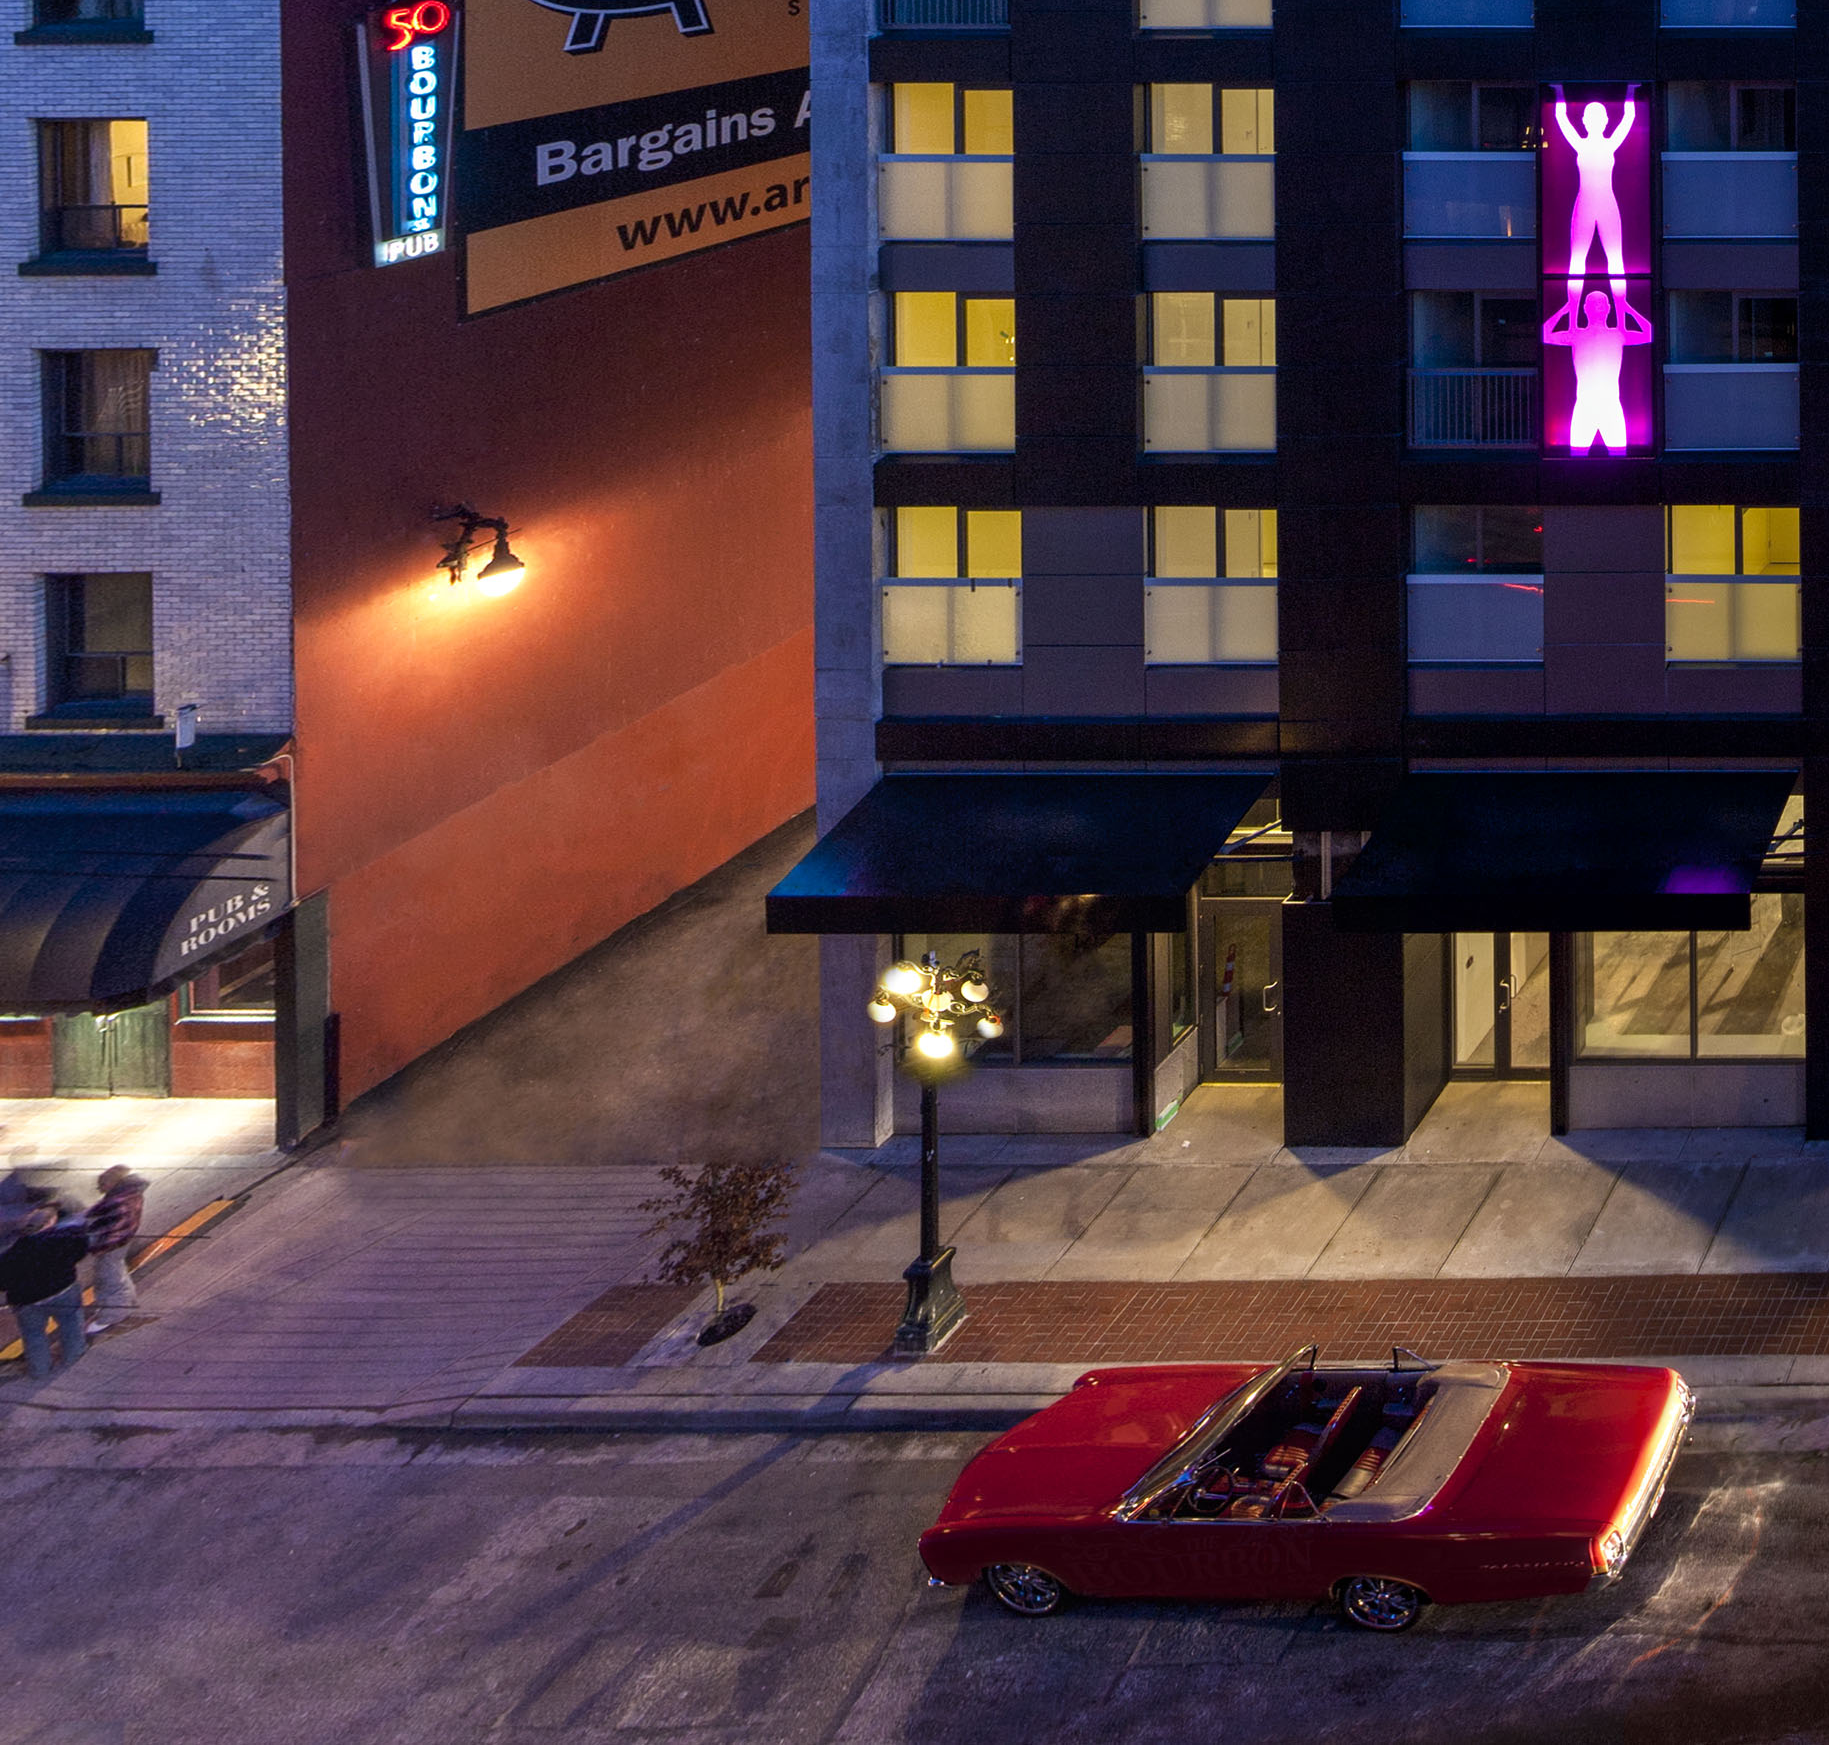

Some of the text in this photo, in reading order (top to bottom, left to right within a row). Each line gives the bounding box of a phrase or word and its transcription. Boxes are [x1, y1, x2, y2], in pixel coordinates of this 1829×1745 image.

[409, 45, 438, 218] BOURBON
[536, 106, 776, 186] Bargains
[386, 232, 440, 262] PUB
[181, 898, 271, 956] ROOMS
[190, 884, 270, 934] PUB &
